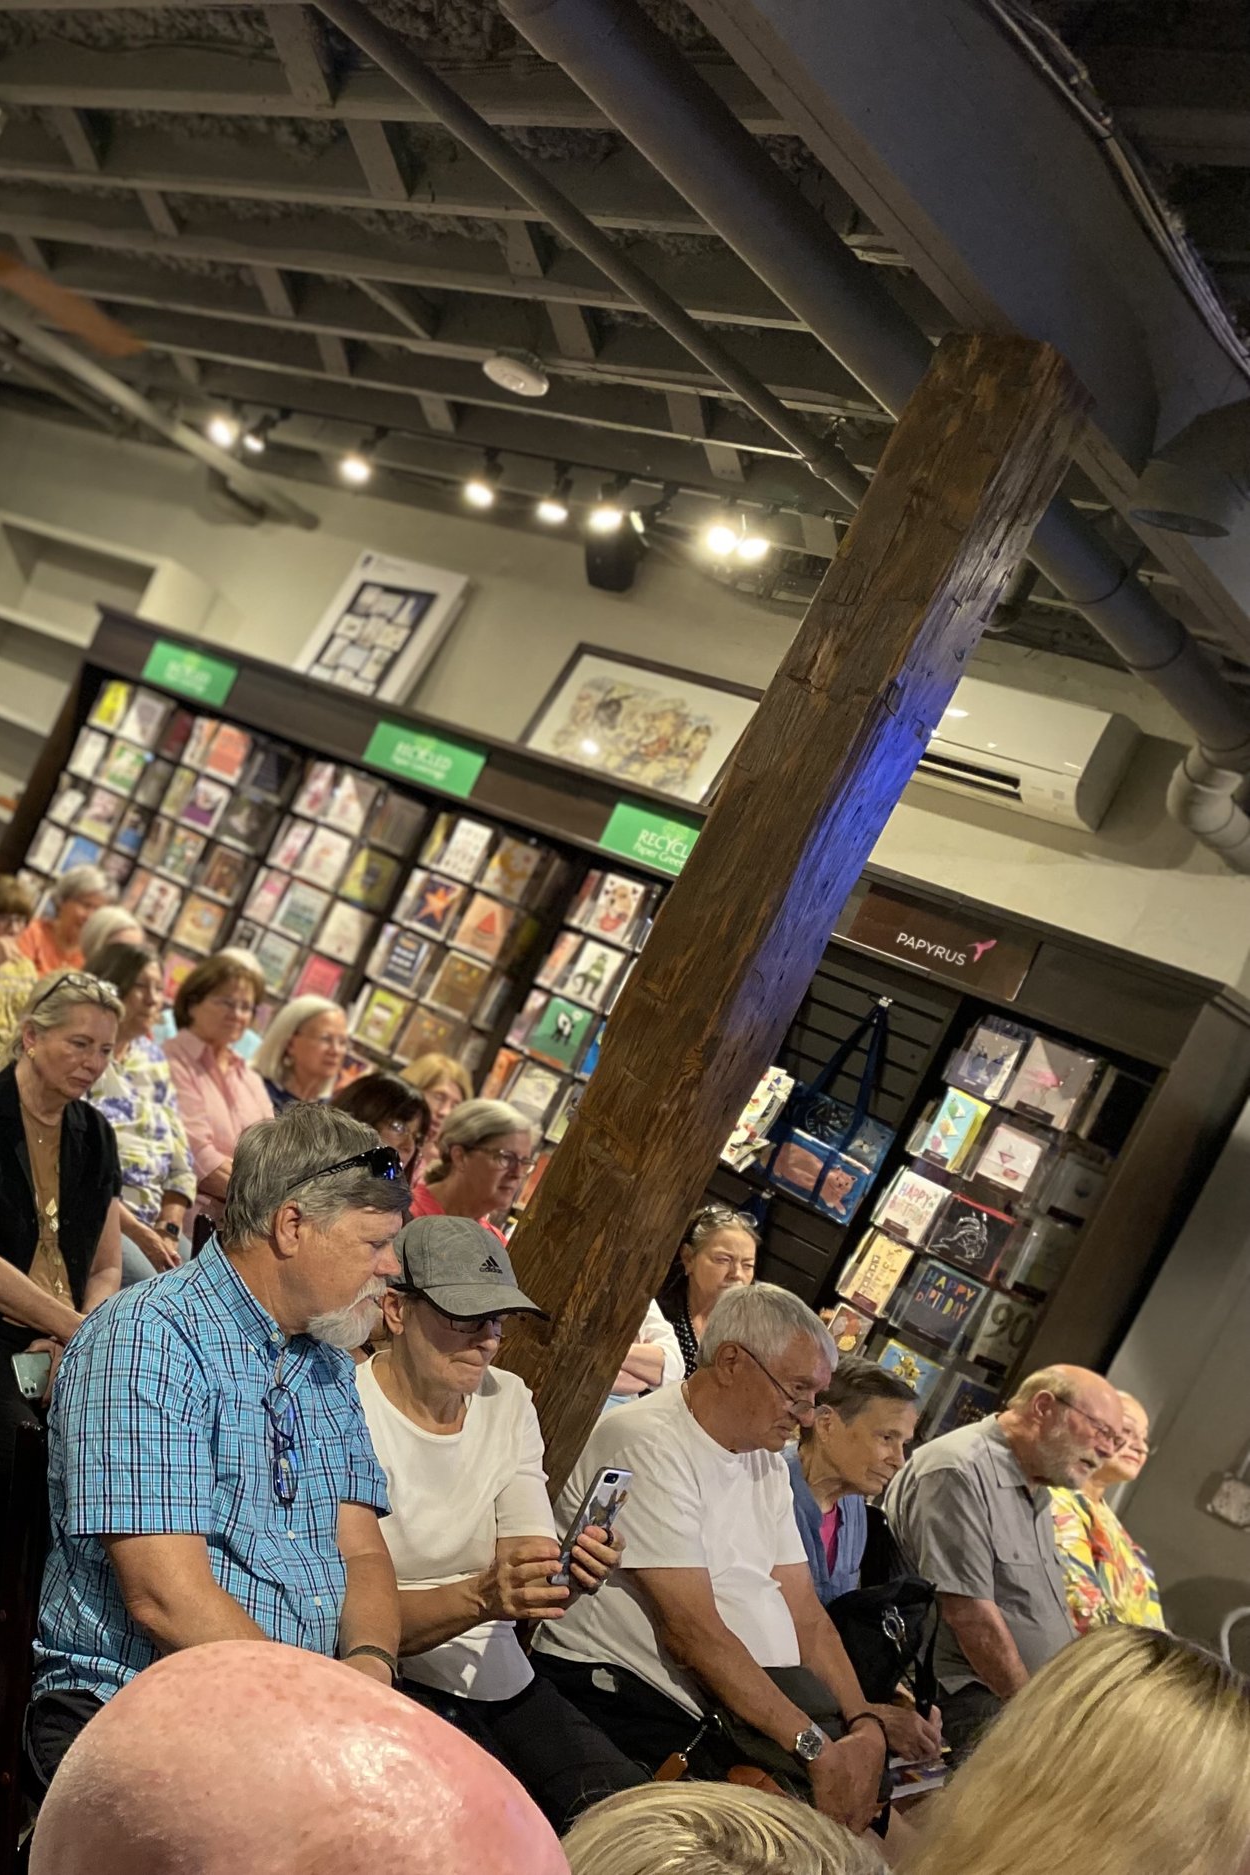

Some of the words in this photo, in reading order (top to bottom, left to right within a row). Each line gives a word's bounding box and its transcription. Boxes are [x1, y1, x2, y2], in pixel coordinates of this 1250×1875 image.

[637, 828, 689, 859] RECYCL
[896, 932, 967, 966] PAPYRUS
[898, 1181, 933, 1209] HAPPY
[925, 1269, 977, 1302] HAPPY
[984, 1302, 1034, 1349] 90
